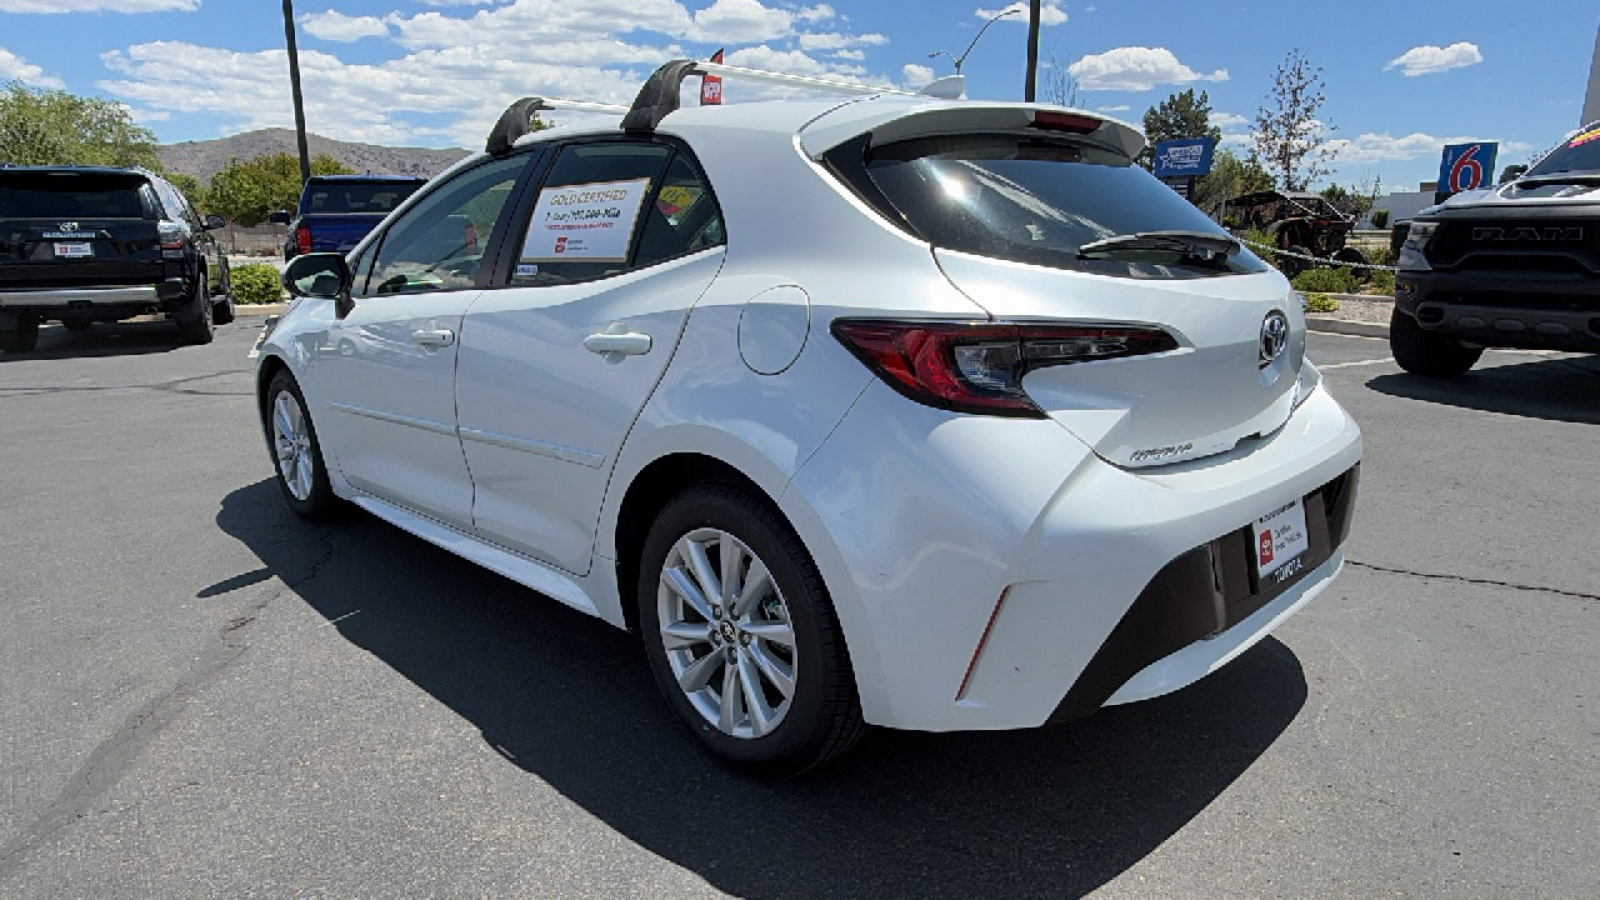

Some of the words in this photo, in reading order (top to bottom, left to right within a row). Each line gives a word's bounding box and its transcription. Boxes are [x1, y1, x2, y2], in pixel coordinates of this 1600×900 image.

[1448, 144, 1483, 193] 6
[550, 193, 577, 206] GOLD
[577, 189, 628, 204] CERTIFIED
[1472, 226, 1584, 241] RAM
[1274, 556, 1303, 584] TOYOTA
